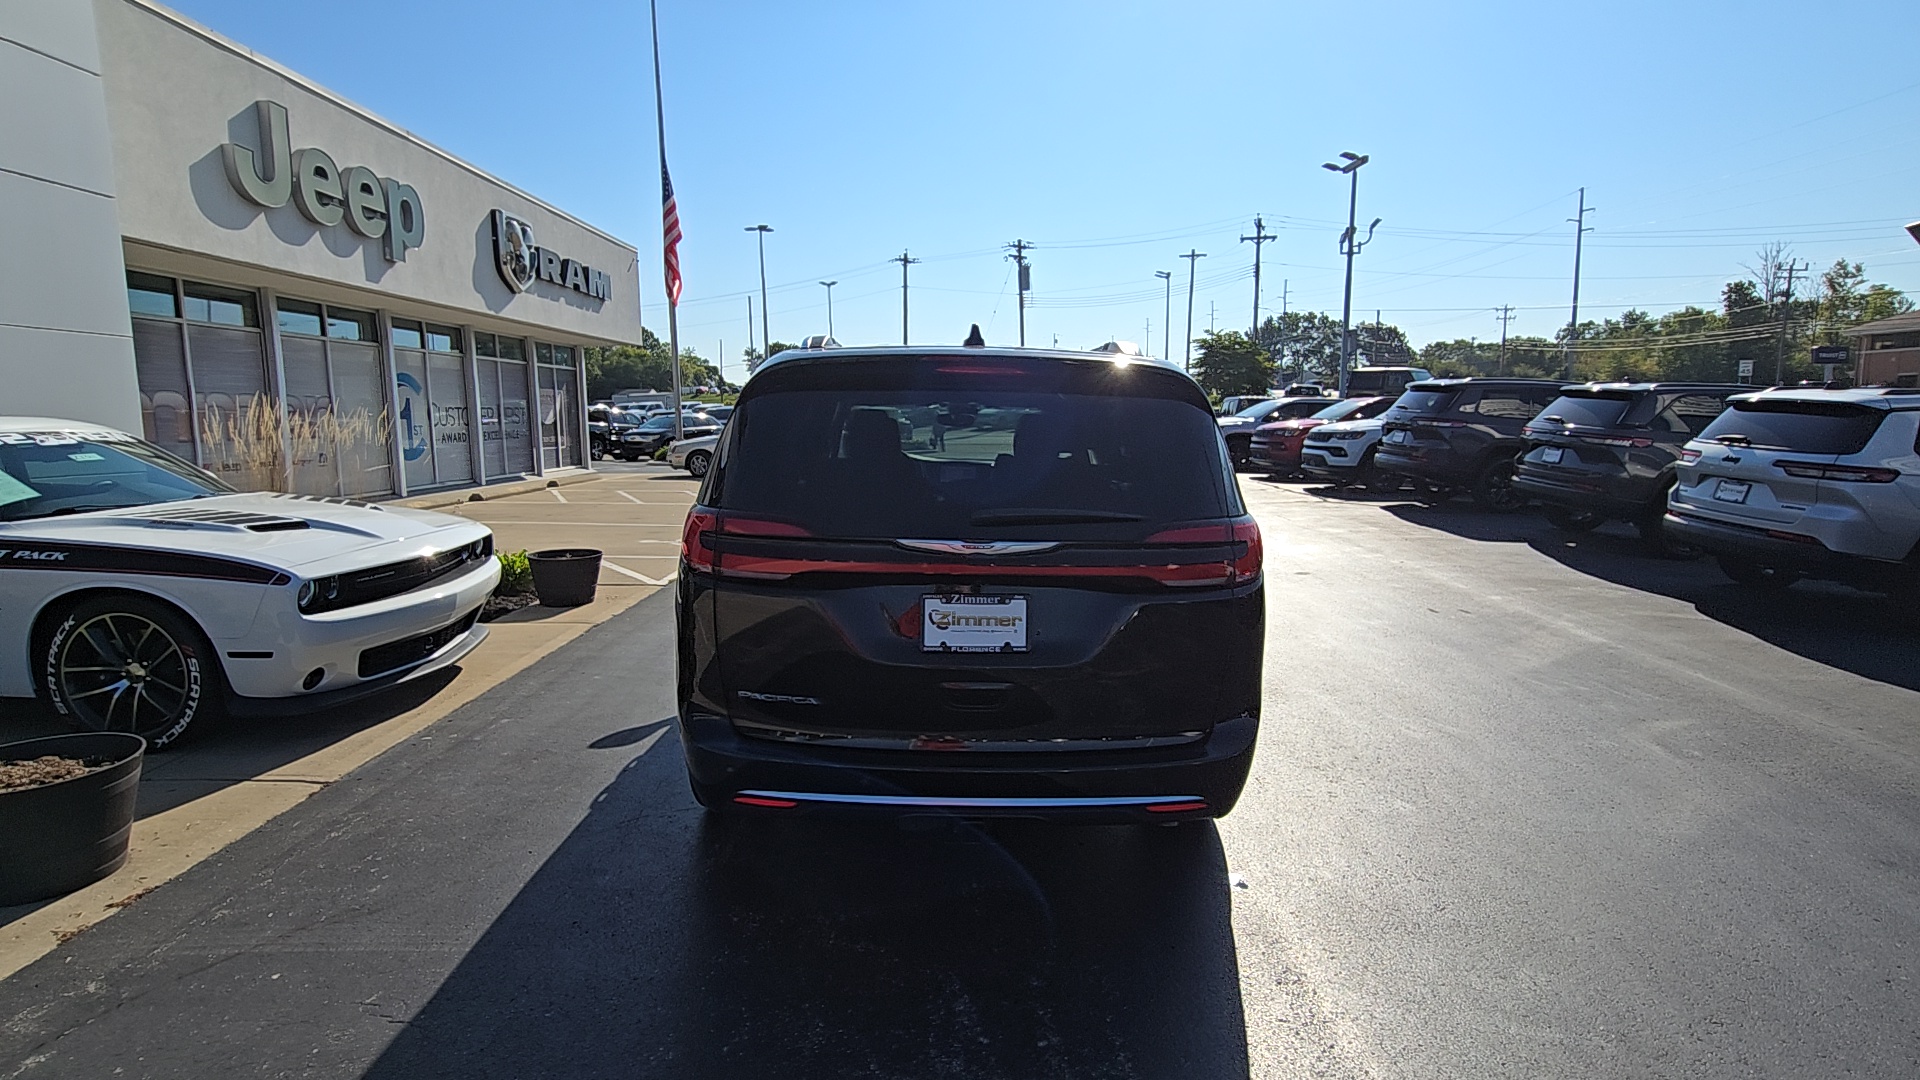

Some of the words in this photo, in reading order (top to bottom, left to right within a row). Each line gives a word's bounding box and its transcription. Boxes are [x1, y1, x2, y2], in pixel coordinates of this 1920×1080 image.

[222, 100, 425, 263] Jeep
[535, 245, 613, 301] RAM
[441, 431, 468, 444] AWARD
[13, 550, 70, 561] PACK
[951, 594, 1001, 604] Zimmer
[934, 610, 1023, 627] Zimmer
[951, 645, 1001, 653] FLORENCE
[154, 657, 201, 748] SCATPACK
[737, 690, 820, 705] PACIFICA
